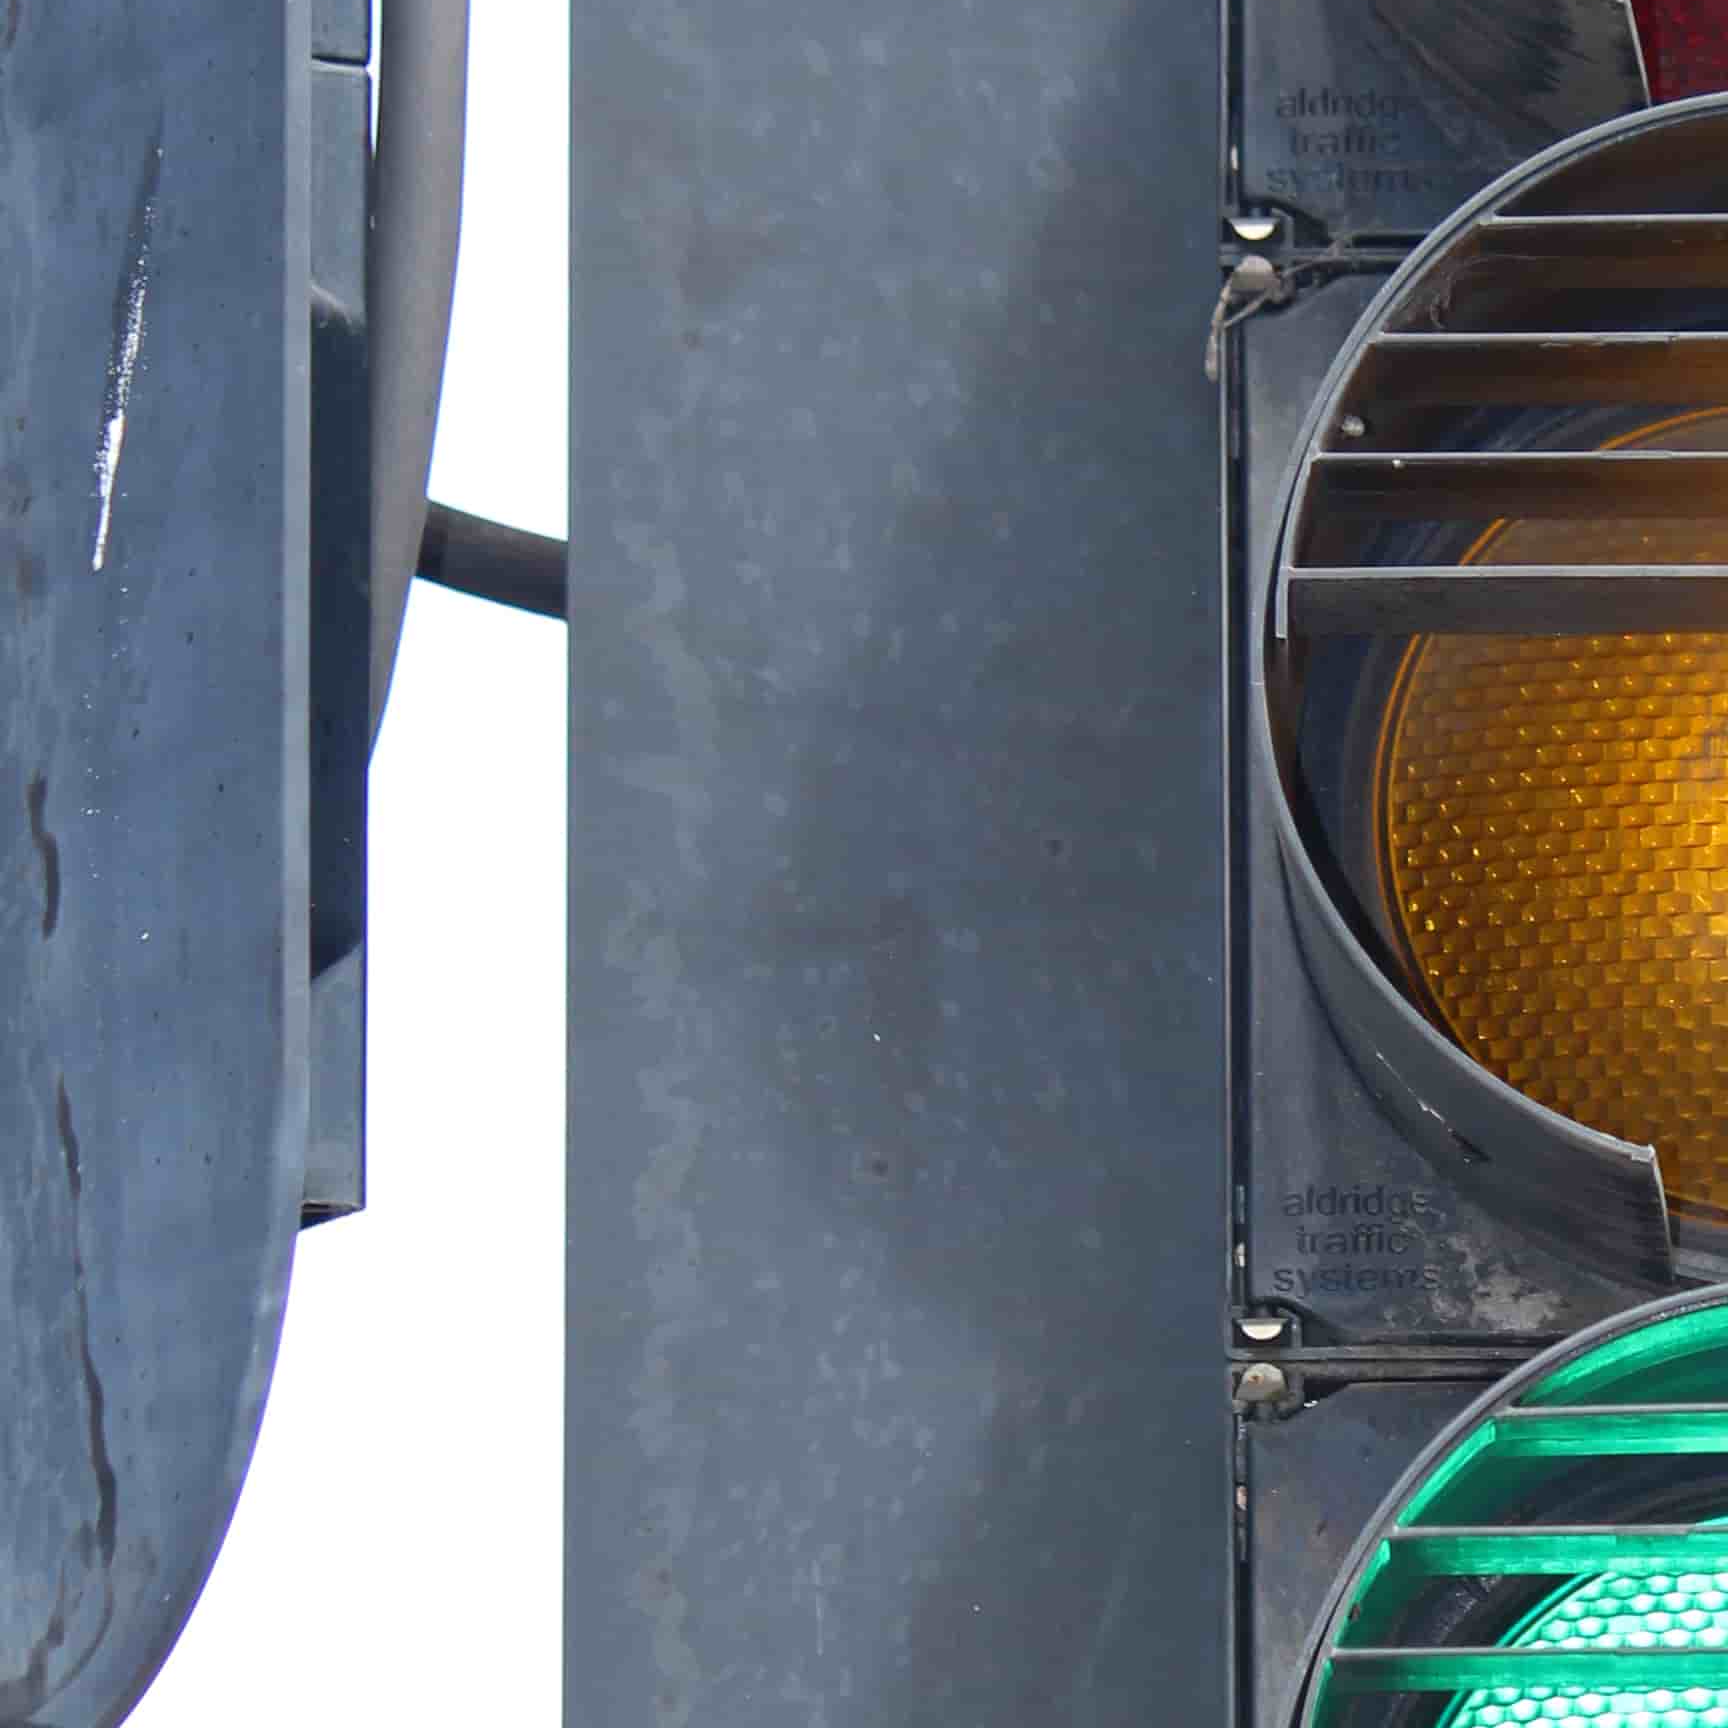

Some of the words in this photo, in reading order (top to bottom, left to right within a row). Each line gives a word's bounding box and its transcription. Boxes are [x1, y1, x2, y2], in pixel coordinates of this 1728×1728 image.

[1275, 87, 1421, 125] aldridg
[1281, 1184, 1430, 1224] aldridge
[1296, 1223, 1411, 1256] traffic
